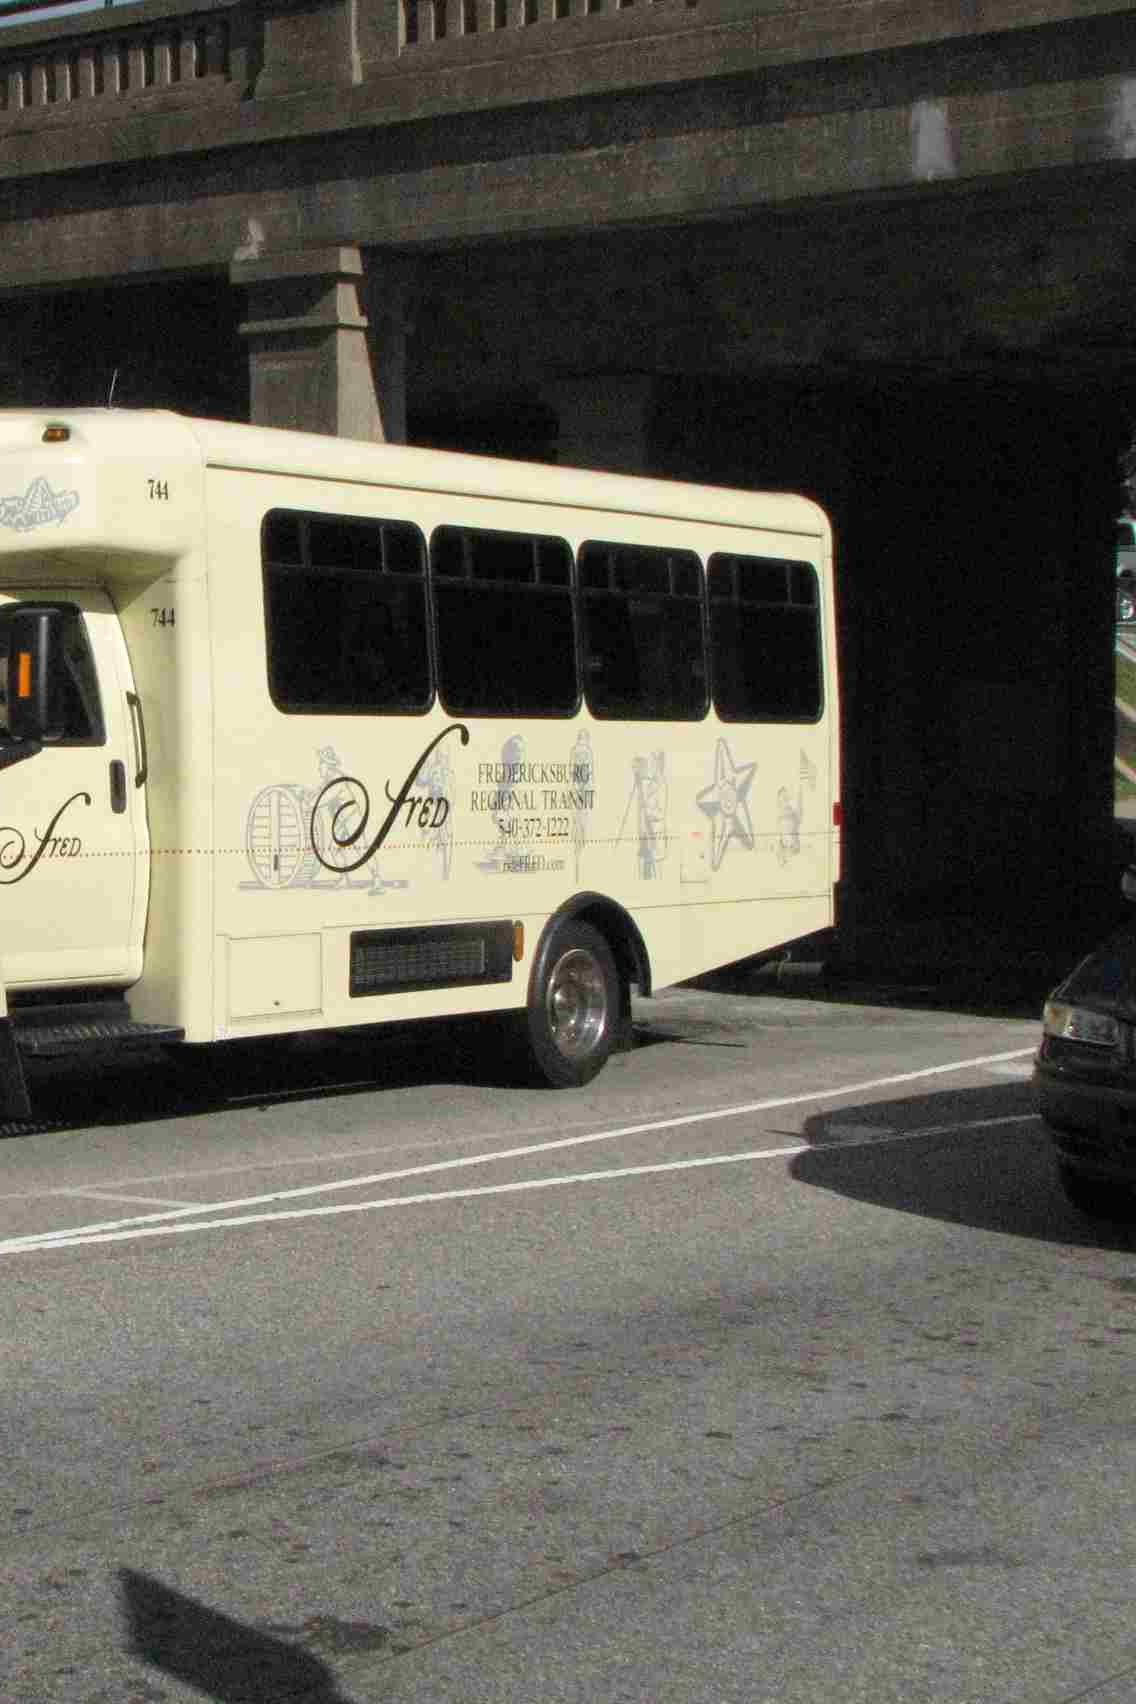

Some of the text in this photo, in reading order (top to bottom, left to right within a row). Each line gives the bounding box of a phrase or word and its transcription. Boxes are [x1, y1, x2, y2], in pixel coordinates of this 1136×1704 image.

[147, 479, 169, 500] 744
[150, 607, 176, 628] 744
[478, 762, 590, 784] FREDERICKSBURG
[471, 789, 596, 811] REGIONAL TRANSIT
[497, 816, 569, 838] 540-372-1222
